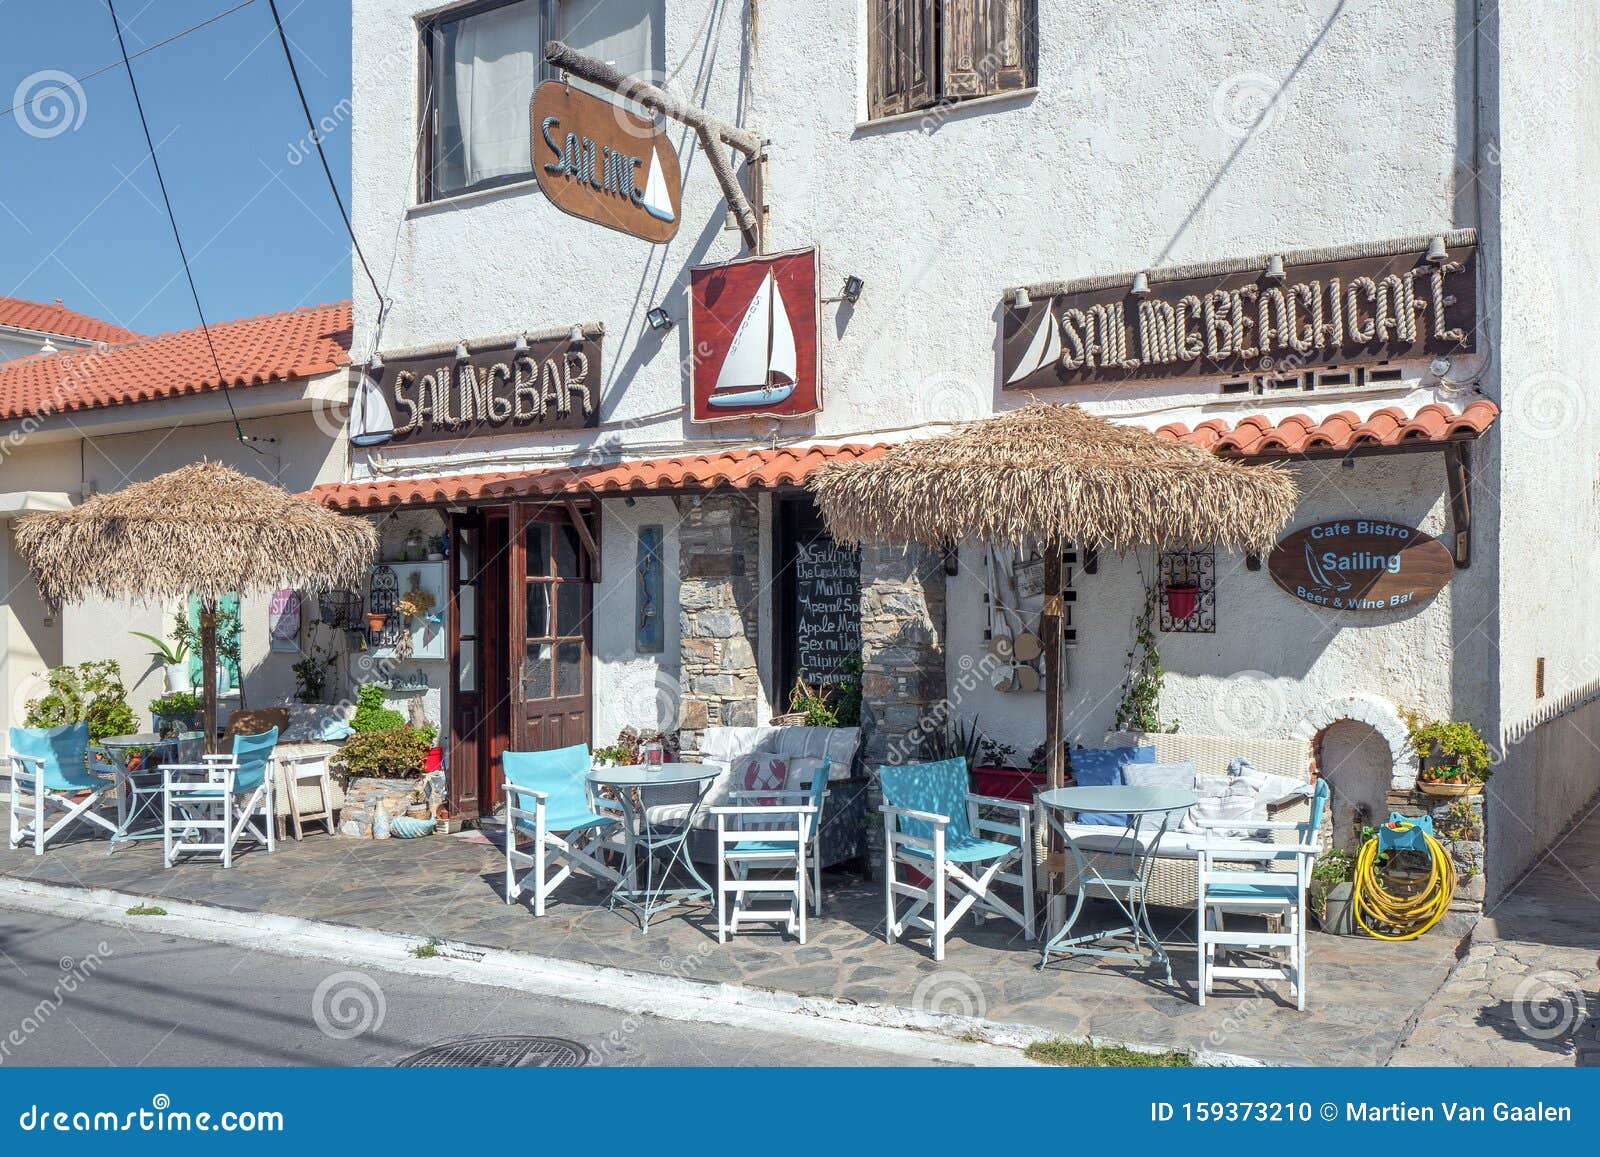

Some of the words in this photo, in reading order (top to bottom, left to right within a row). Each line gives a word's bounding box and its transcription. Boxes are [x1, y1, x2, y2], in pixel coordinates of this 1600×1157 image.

[1311, 522, 1350, 539] Cafe
[1357, 521, 1409, 539] Bistro
[1322, 552, 1401, 574] Sailing
[1297, 586, 1328, 605] Beer
[1333, 597, 1343, 608] &
[1349, 597, 1385, 609] Wine
[1390, 592, 1415, 606] Bar
[799, 614, 835, 636] Apple
[799, 635, 824, 650] Sex
